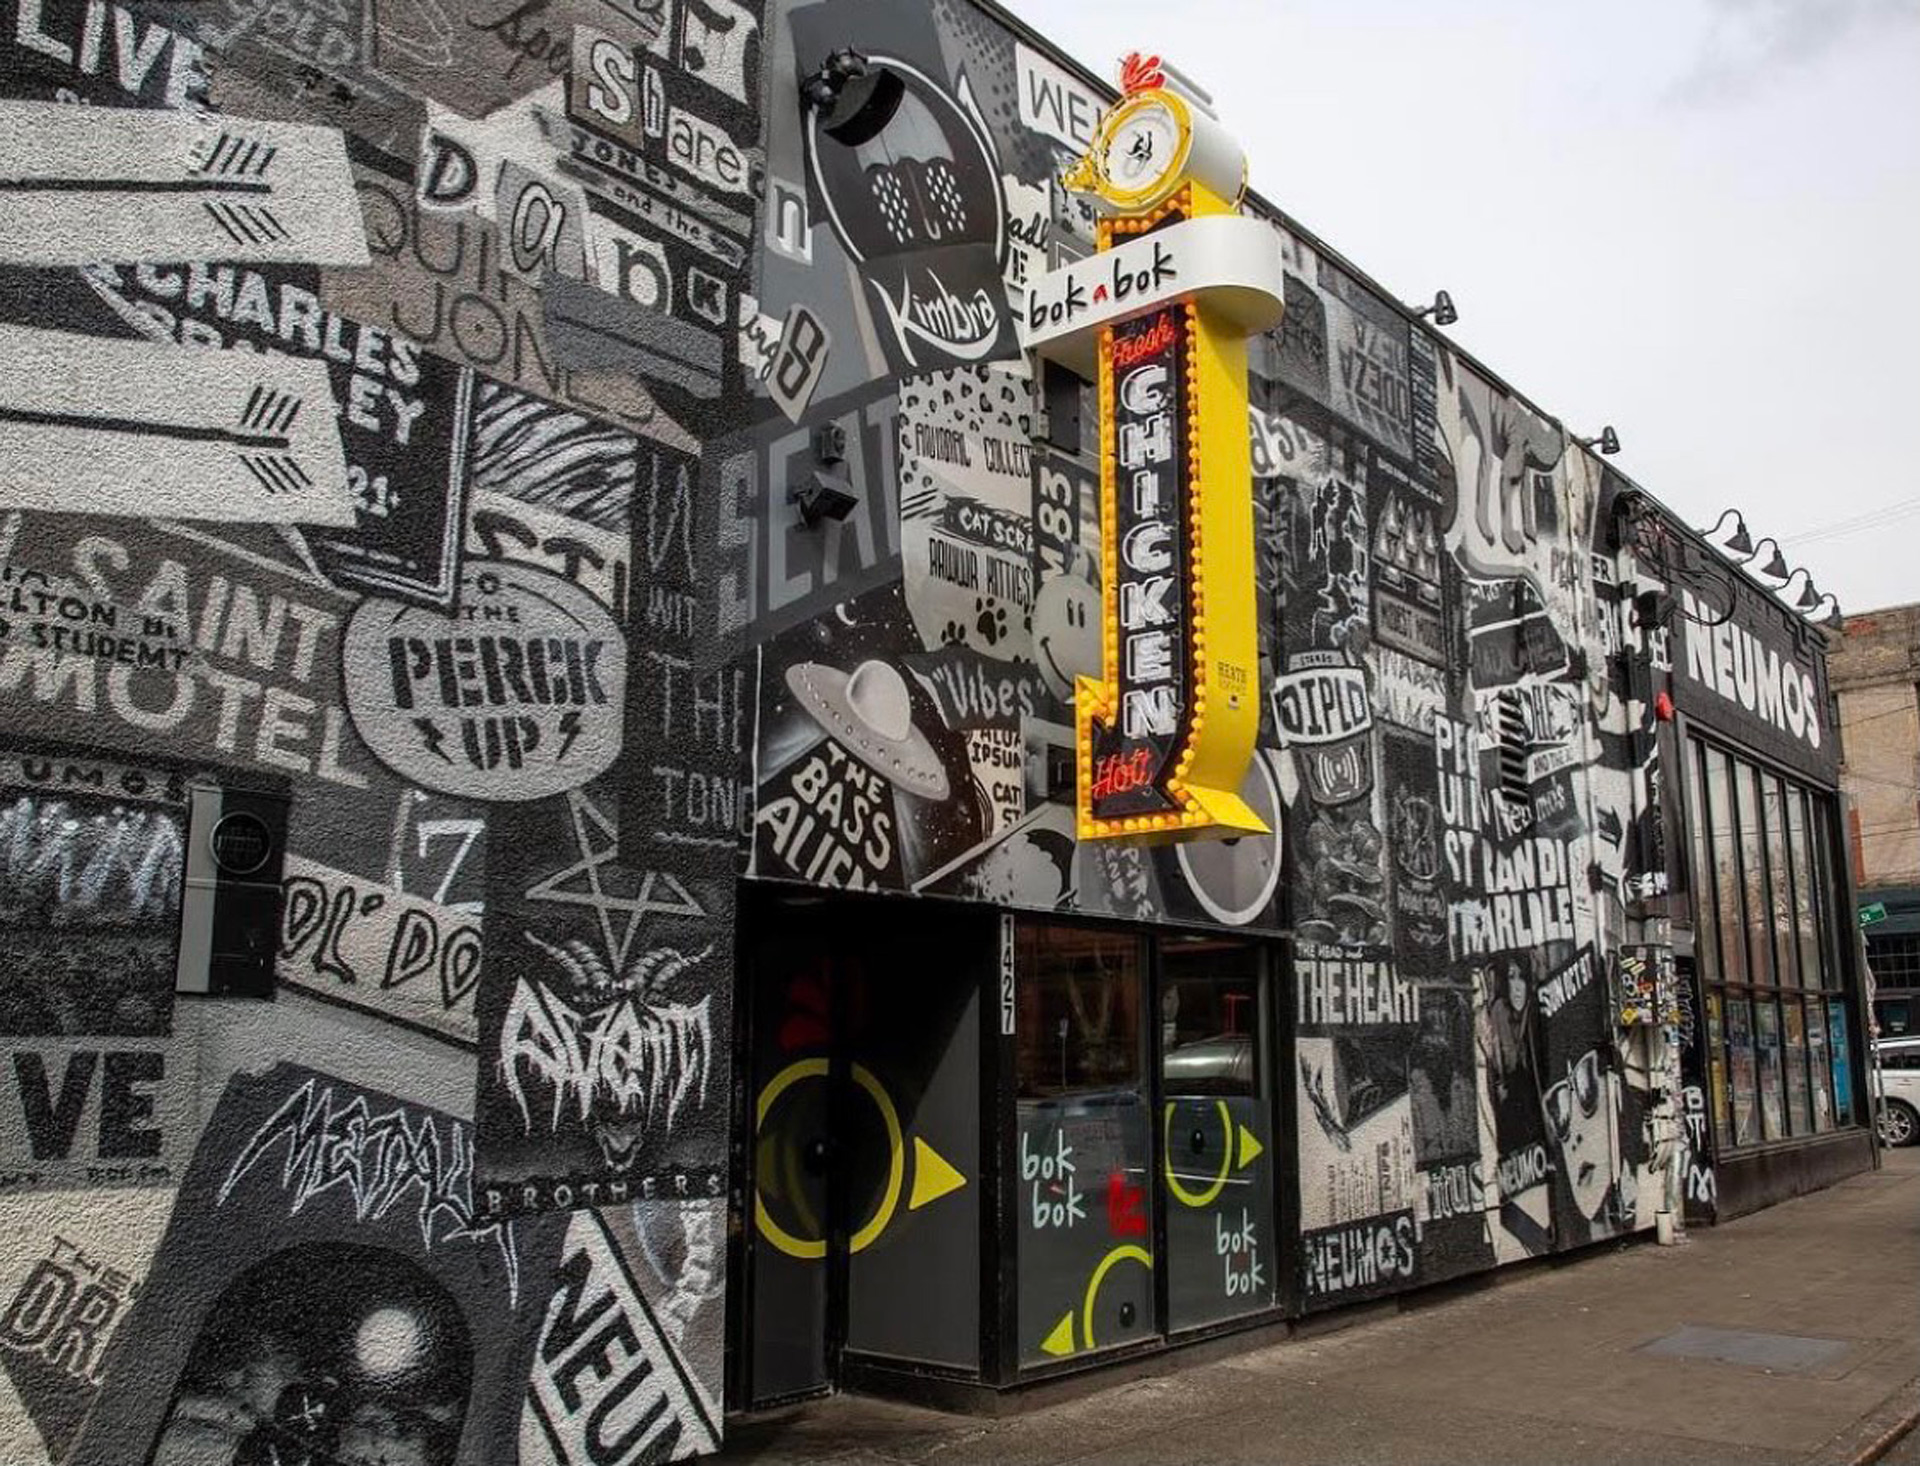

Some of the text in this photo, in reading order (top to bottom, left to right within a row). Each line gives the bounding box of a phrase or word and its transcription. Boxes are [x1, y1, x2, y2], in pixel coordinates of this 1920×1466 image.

[1029, 275, 1087, 330] bok
[1113, 242, 1177, 300] bok
[136, 260, 422, 388] CHARLES
[1119, 363, 1178, 742] CHICKEN
[1681, 588, 1821, 750] NEUMOS
[461, 715, 541, 771] UP
[791, 756, 892, 871] BASS
[1022, 1128, 1076, 1180] bok
[485, 1173, 727, 1213] BROTHERS
[1033, 1175, 1087, 1229] bok
[1216, 1206, 1258, 1255] bok
[1225, 1249, 1267, 1297] bok
